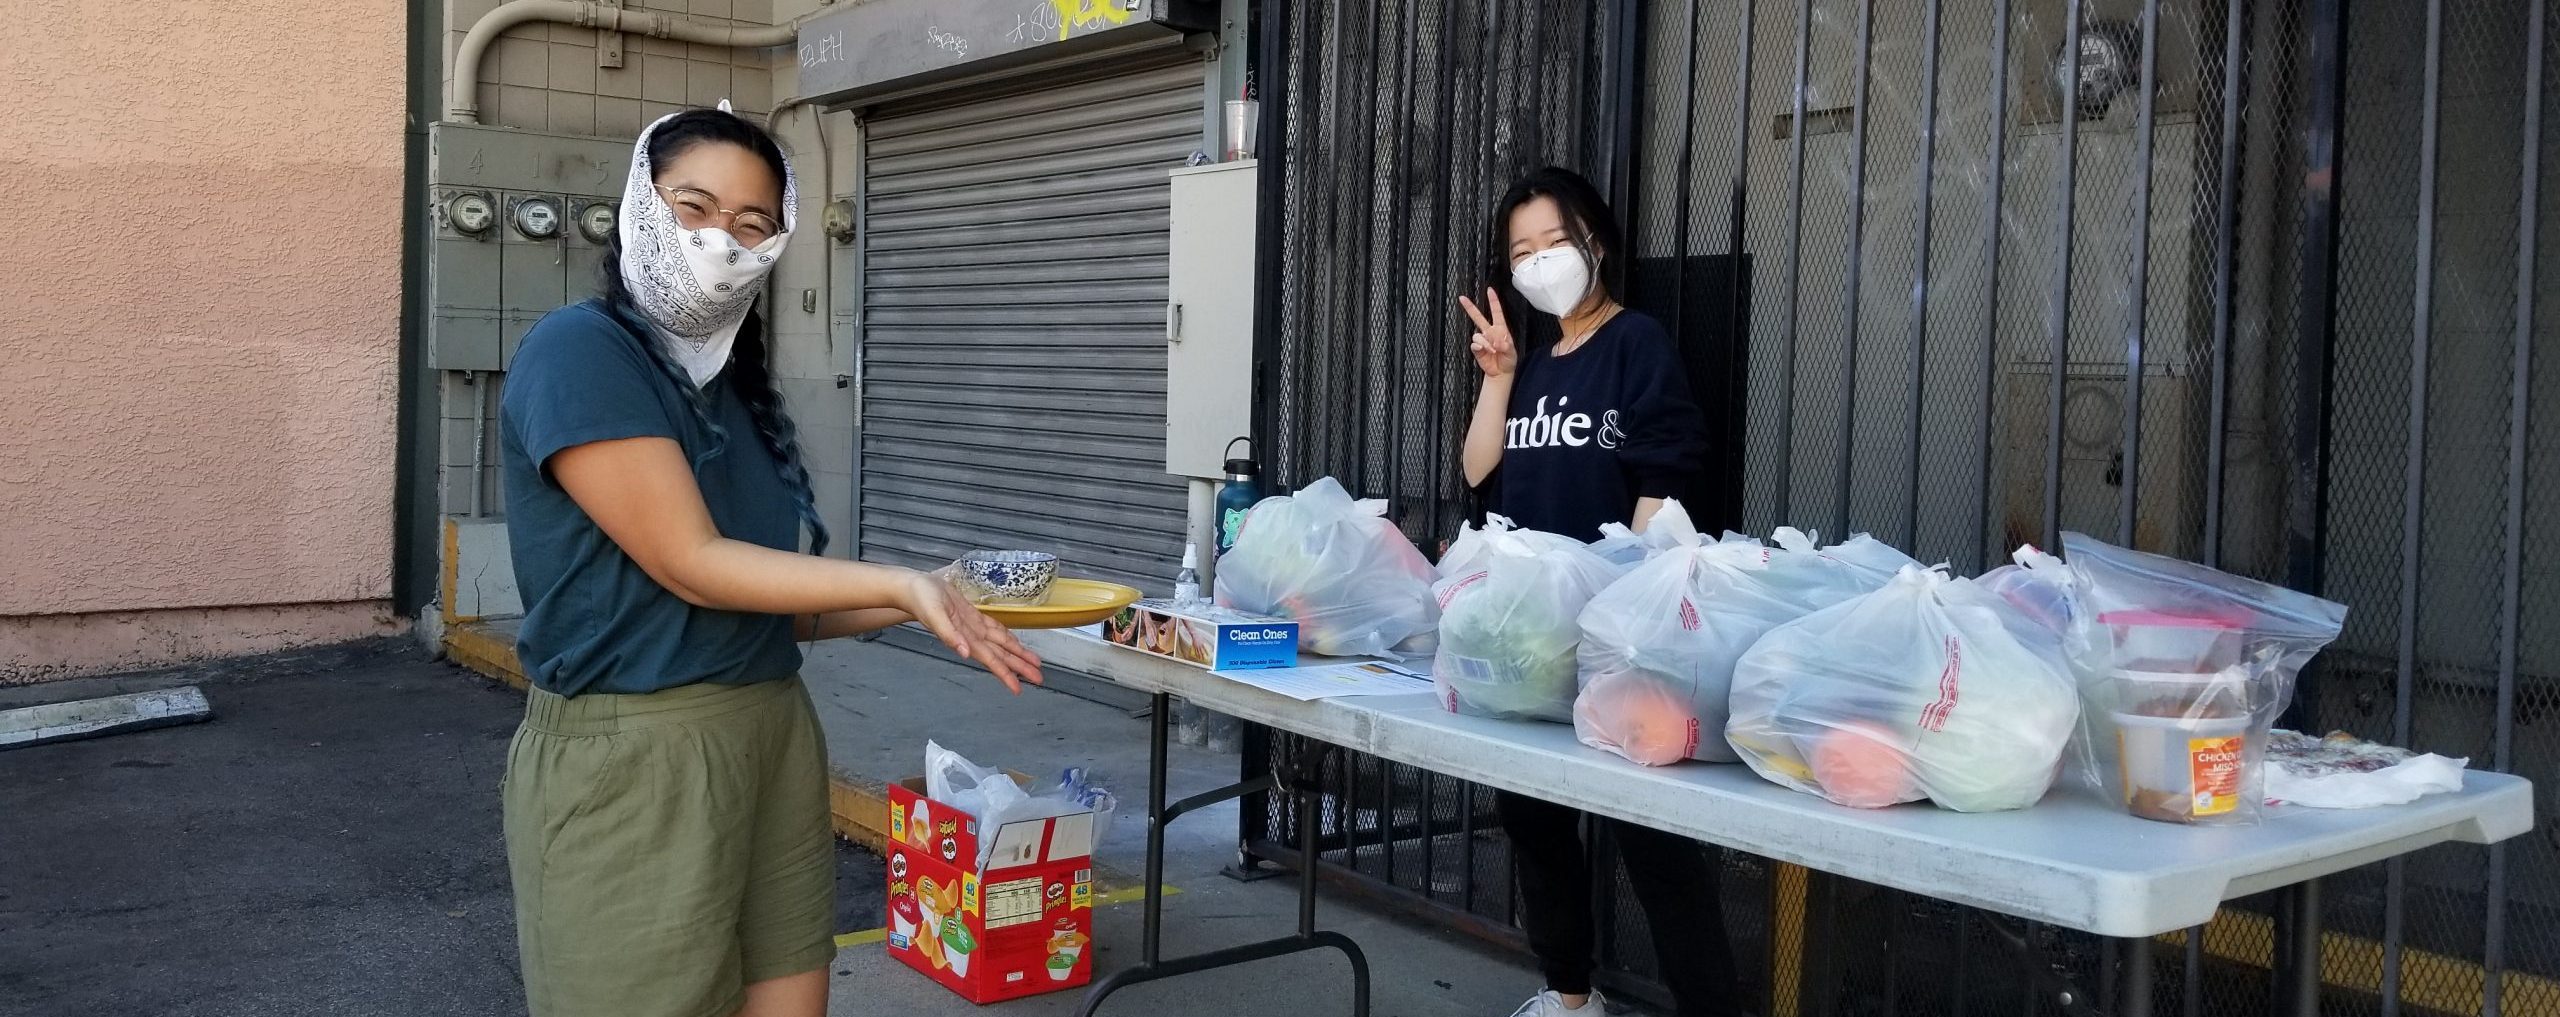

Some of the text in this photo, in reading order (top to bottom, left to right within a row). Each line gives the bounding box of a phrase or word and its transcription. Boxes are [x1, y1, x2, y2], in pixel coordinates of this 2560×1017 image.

[1229, 628, 1288, 641] Clean Ones
[1075, 884, 1088, 896] 48
[1045, 895, 1067, 914] Pringles
